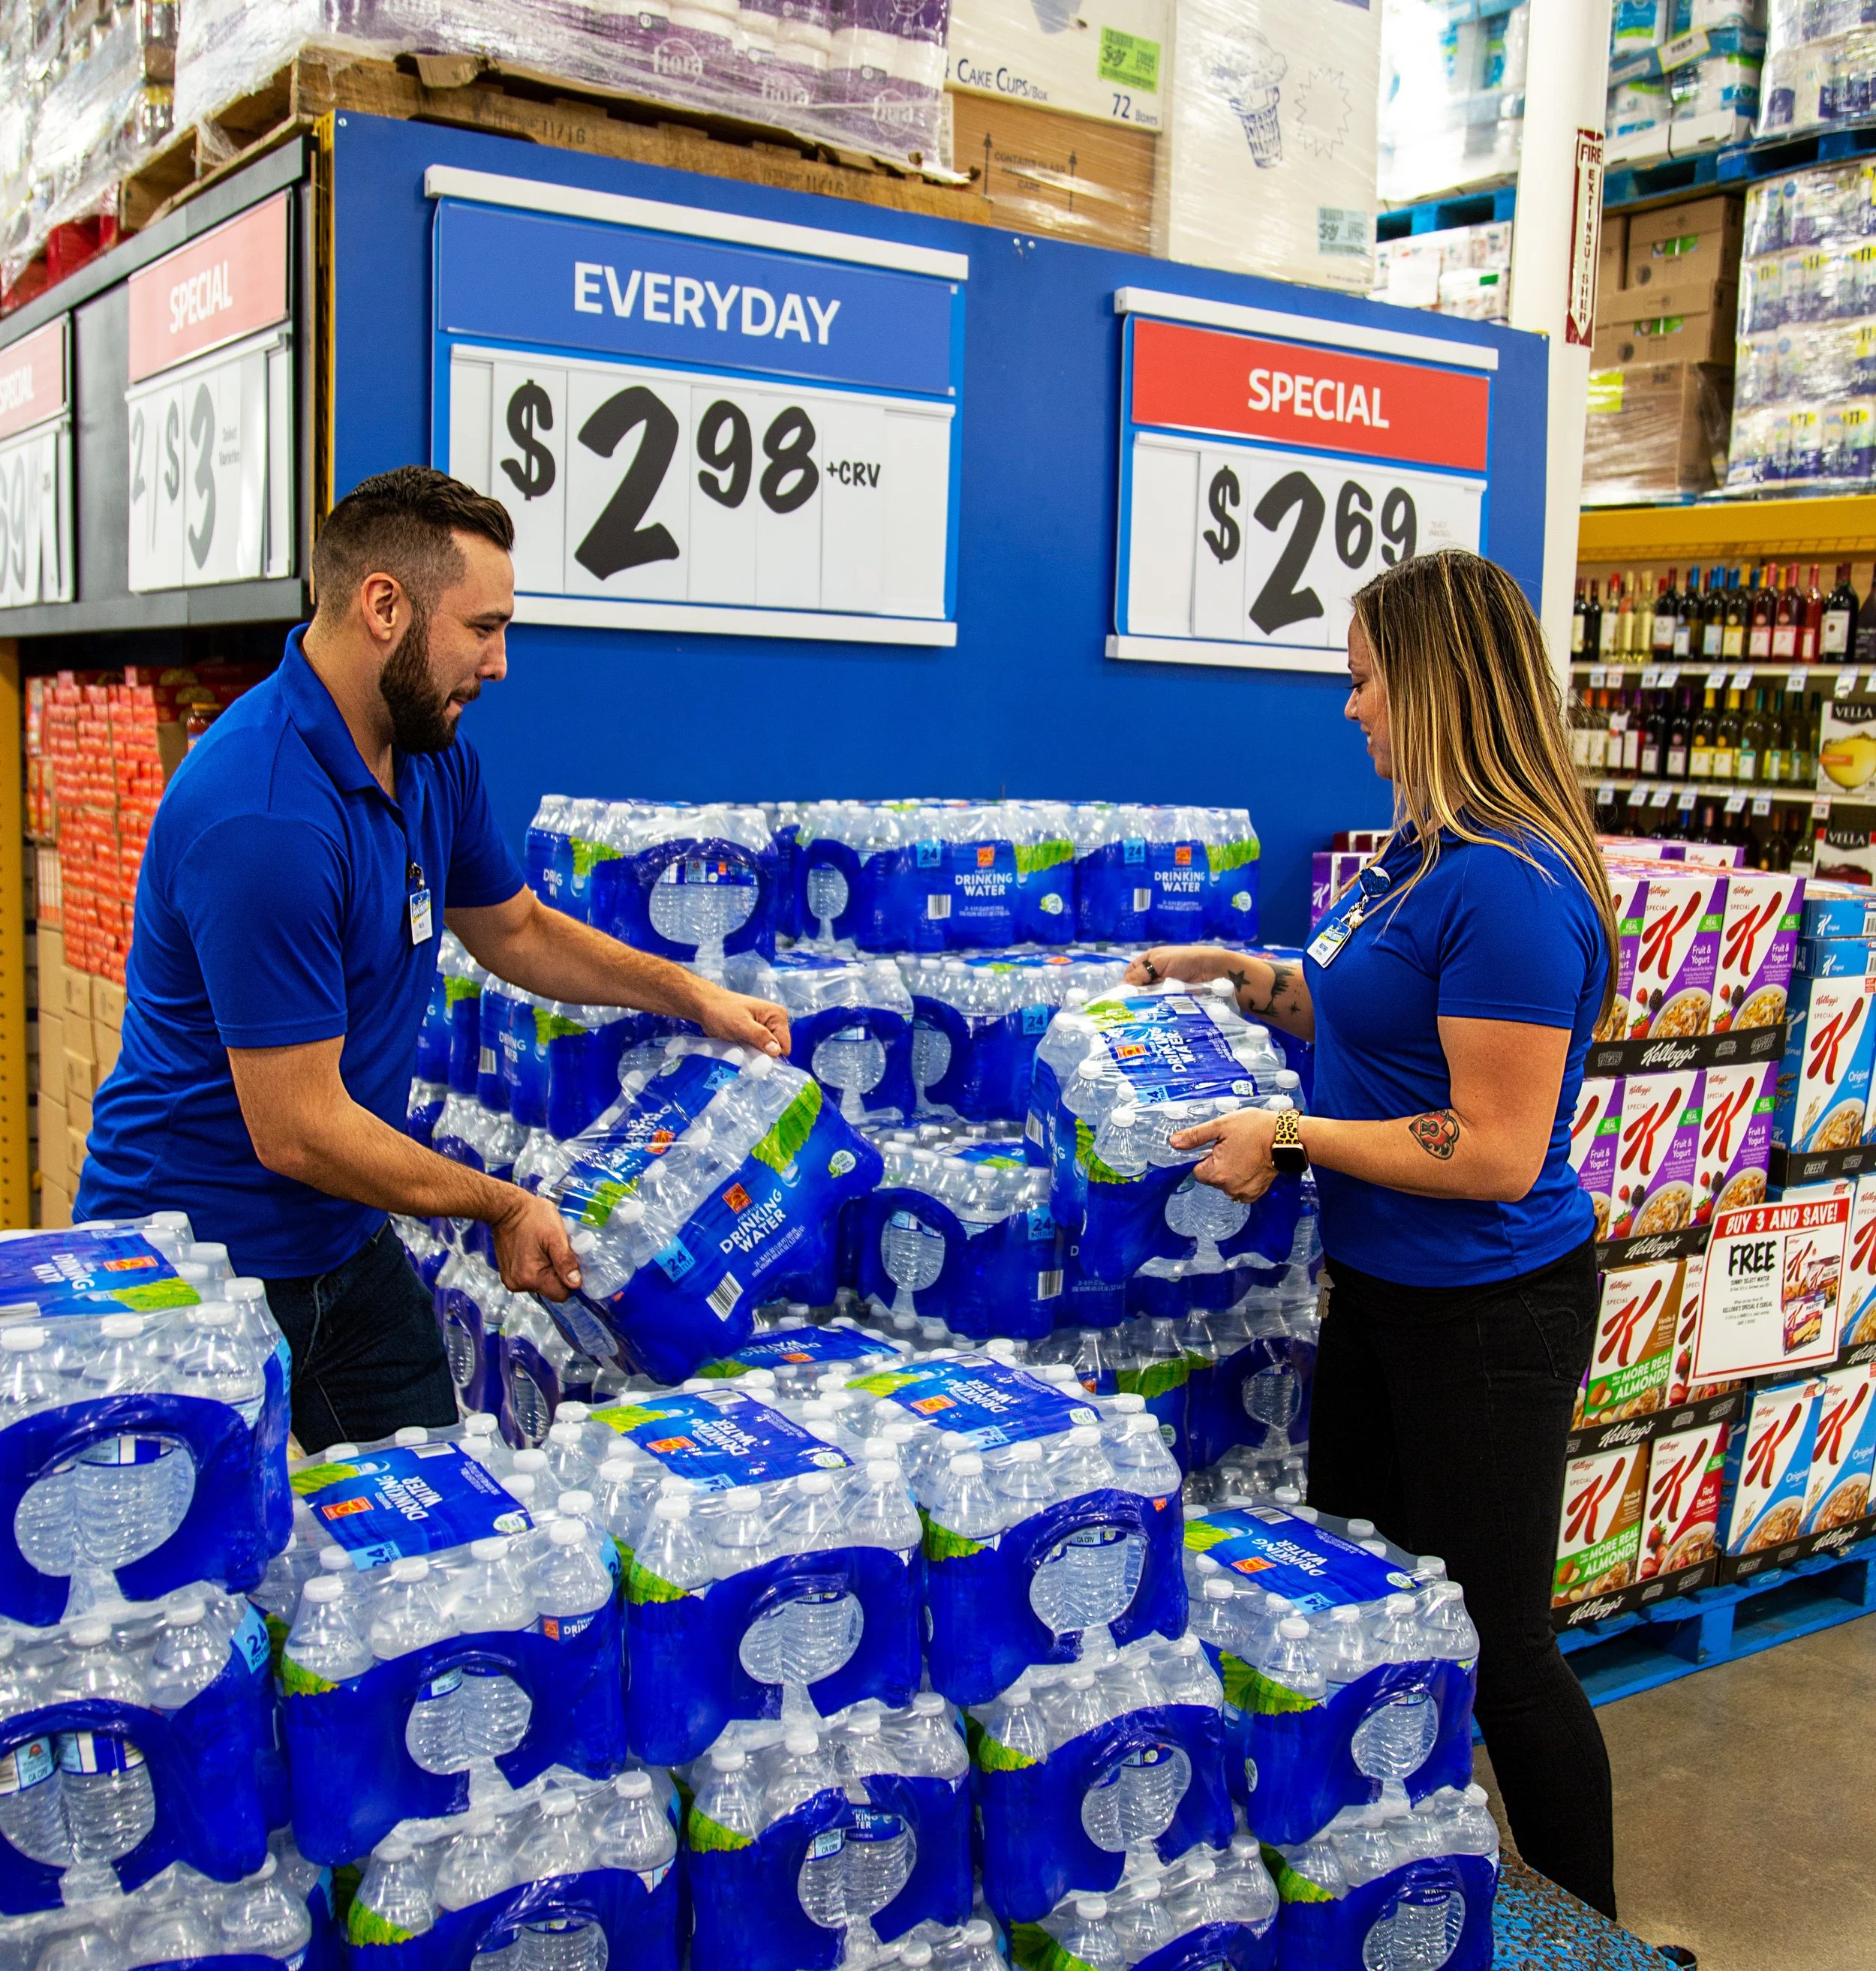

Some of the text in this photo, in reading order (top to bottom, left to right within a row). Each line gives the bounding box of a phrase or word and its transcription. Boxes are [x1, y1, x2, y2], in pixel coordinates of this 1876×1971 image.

[1112, 92, 1131, 119] 72
[1580, 143, 1601, 164] FIRE
[1579, 169, 1595, 324] EXTINGUISHER
[170, 260, 233, 335] SPECIAL
[573, 261, 840, 345] EVERYDAY
[1248, 368, 1390, 429] SPECIAL
[826, 460, 881, 489] +CRV
[1835, 705, 1874, 720] VELLA
[1828, 831, 1865, 846] VELLA
[921, 848, 938, 861] 24
[1128, 846, 1141, 857] 24
[955, 873, 1013, 886] DRINKING
[1154, 871, 1205, 882] DRINKING
[964, 884, 1006, 897] WATER
[1162, 882, 1201, 893] WATER
[1312, 883, 1330, 909] K
[1648, 885, 1672, 897] Kellogg's
[1732, 885, 1754, 897] Kellogg's
[1705, 917, 1717, 926] REAL
[1784, 916, 1796, 926] REAL
[1638, 891, 1702, 981] K
[1722, 891, 1782, 978] K
[1692, 945, 1711, 955] Fruit &
[1771, 943, 1790, 954] Fruit &
[1691, 955, 1710, 966] Yogurt
[1771, 953, 1788, 964] Yogurt
[1815, 995, 1839, 1007] Kellogg's
[1027, 1014, 1044, 1028] 24
[1149, 1026, 1188, 1073] DRINKING
[1166, 1029, 1196, 1064] WATER
[1807, 996, 1865, 1086] K
[1640, 1041, 1700, 1068] Kellogg's
[1708, 1074, 1727, 1085] Kellogg's
[1848, 1069, 1870, 1084] Original
[1628, 1085, 1652, 1096] Kellogg's
[1759, 1099, 1770, 1108] REAL
[1685, 1111, 1697, 1121] REAL
[1701, 1076, 1755, 1163] K
[1620, 1086, 1682, 1176] K
[1748, 1126, 1766, 1137] Fruit &
[1673, 1138, 1692, 1149] Fruit &
[1747, 1135, 1765, 1146] Yogurt
[1590, 1148, 1610, 1159] Fruit &
[1673, 1148, 1691, 1159] Yogurt
[1589, 1158, 1610, 1169] Yogurt
[719, 1188, 783, 1254] DRINKING
[1033, 1218, 1051, 1232] 24
[1725, 1202, 1838, 1236] BUY 3 AND SAVE!
[738, 1208, 787, 1253] WATER
[1624, 1236, 1683, 1259] Kellogg's
[666, 1249, 687, 1272] 24
[1727, 1239, 1777, 1276] FREE
[1609, 1278, 1633, 1291] Kellogg's
[1598, 1279, 1662, 1367] SPECIAL K
[1658, 1316, 1672, 1325] Vanilla
[1658, 1322, 1674, 1332] Almond
[1621, 1351, 1670, 1380] MORE REAL
[965, 1378, 1014, 1402] WATER
[1614, 1365, 1670, 1402] ALMONDS
[940, 1378, 1010, 1414] DRINKING
[1754, 1405, 1776, 1419] Kellogg's
[1812, 1382, 1869, 1465] K
[686, 1418, 750, 1456] DRINKING
[710, 1418, 757, 1447] WATER
[976, 1429, 1000, 1444] 24
[1598, 1420, 1656, 1448] Kellogg's
[1658, 1441, 1680, 1453] Kellogg's
[1744, 1402, 1802, 1489] SPECIAL K
[1852, 1444, 1875, 1461] Original
[1571, 1460, 1595, 1472] Kellogg's
[1655, 1457, 1677, 1466] SPECIAL
[1649, 1438, 1709, 1522] K
[1786, 1466, 1809, 1484] Original
[401, 1475, 443, 1509] WATER
[702, 1478, 726, 1492] 24
[1702, 1486, 1714, 1498] Red
[374, 1475, 429, 1522] DRINKING
[1564, 1456, 1625, 1545] SPECIAL K
[1696, 1496, 1717, 1510] Berries
[1589, 1528, 1639, 1560] MORE REAL
[1811, 1525, 1859, 1552] Kellogg's
[365, 1546, 391, 1567] 24
[1252, 1537, 1327, 1576] DRINKING
[1276, 1539, 1328, 1567] WATER
[1583, 1541, 1638, 1578] ALMONDS
[1303, 1597, 1327, 1611] 24
[1567, 1595, 1625, 1624] Kellogg's
[246, 1622, 267, 1652] 24
[29, 1767, 48, 1783] CA CRV
[821, 1842, 838, 1854] CA CRV
